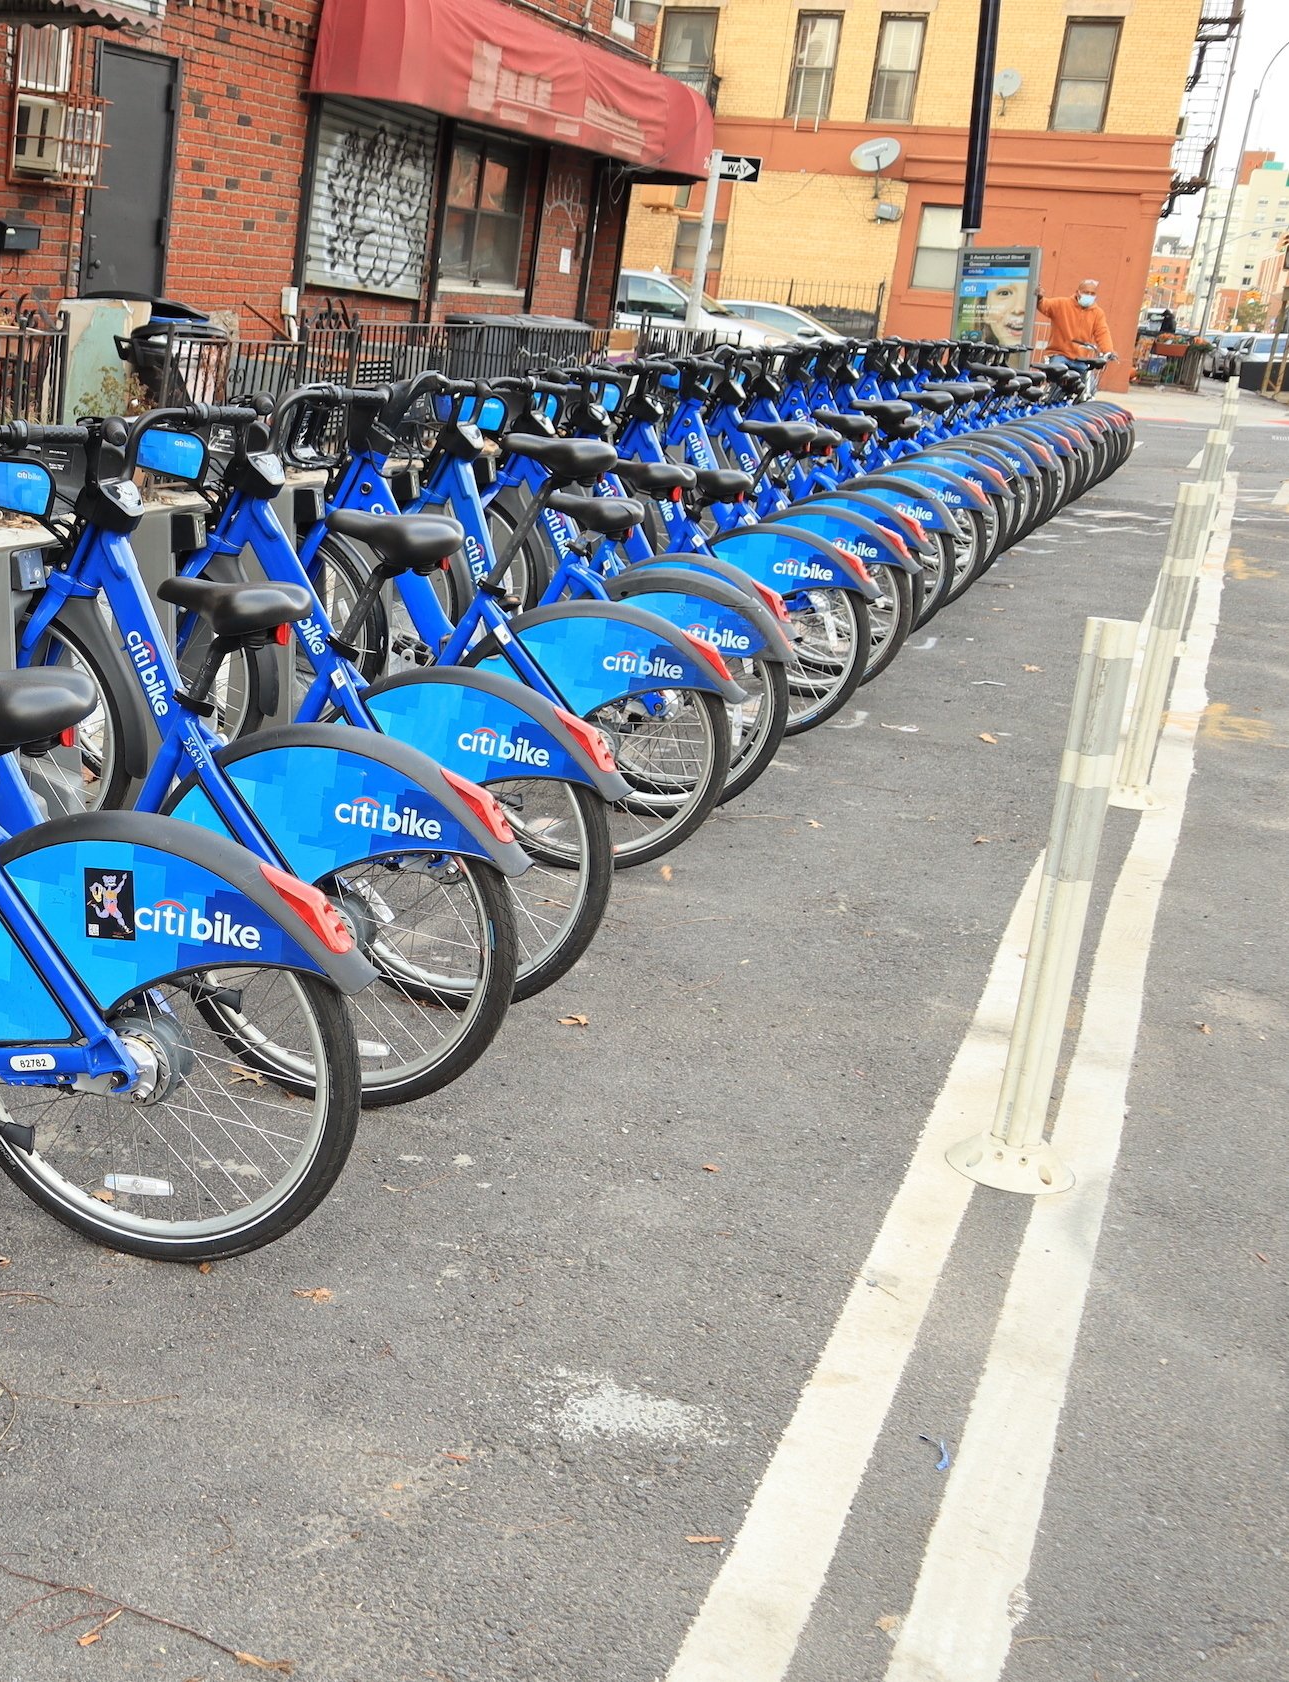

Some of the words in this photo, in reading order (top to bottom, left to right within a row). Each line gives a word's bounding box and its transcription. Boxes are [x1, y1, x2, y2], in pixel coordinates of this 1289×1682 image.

[727, 162, 749, 175] WAY
[688, 432, 705, 452] citi
[695, 449, 710, 470] bik
[17, 470, 28, 479] citi
[28, 472, 42, 480] bike
[544, 508, 567, 531] citi
[906, 506, 933, 521] bike
[466, 536, 484, 563] citi
[553, 528, 572, 560] bik
[847, 541, 878, 558] bike
[773, 558, 800, 576] citi
[800, 562, 834, 581] bike
[127, 630, 156, 669] citi
[708, 627, 750, 650] bike
[602, 650, 639, 673] citi
[639, 655, 684, 680] bike
[140, 664, 169, 717] bike
[457, 727, 499, 756] citi
[498, 734, 550, 768] bike
[334, 797, 382, 829] citi
[382, 804, 442, 841] bike
[134, 900, 189, 937] citi
[190, 908, 262, 950] bike
[19, 1058, 47, 1068] 82782
